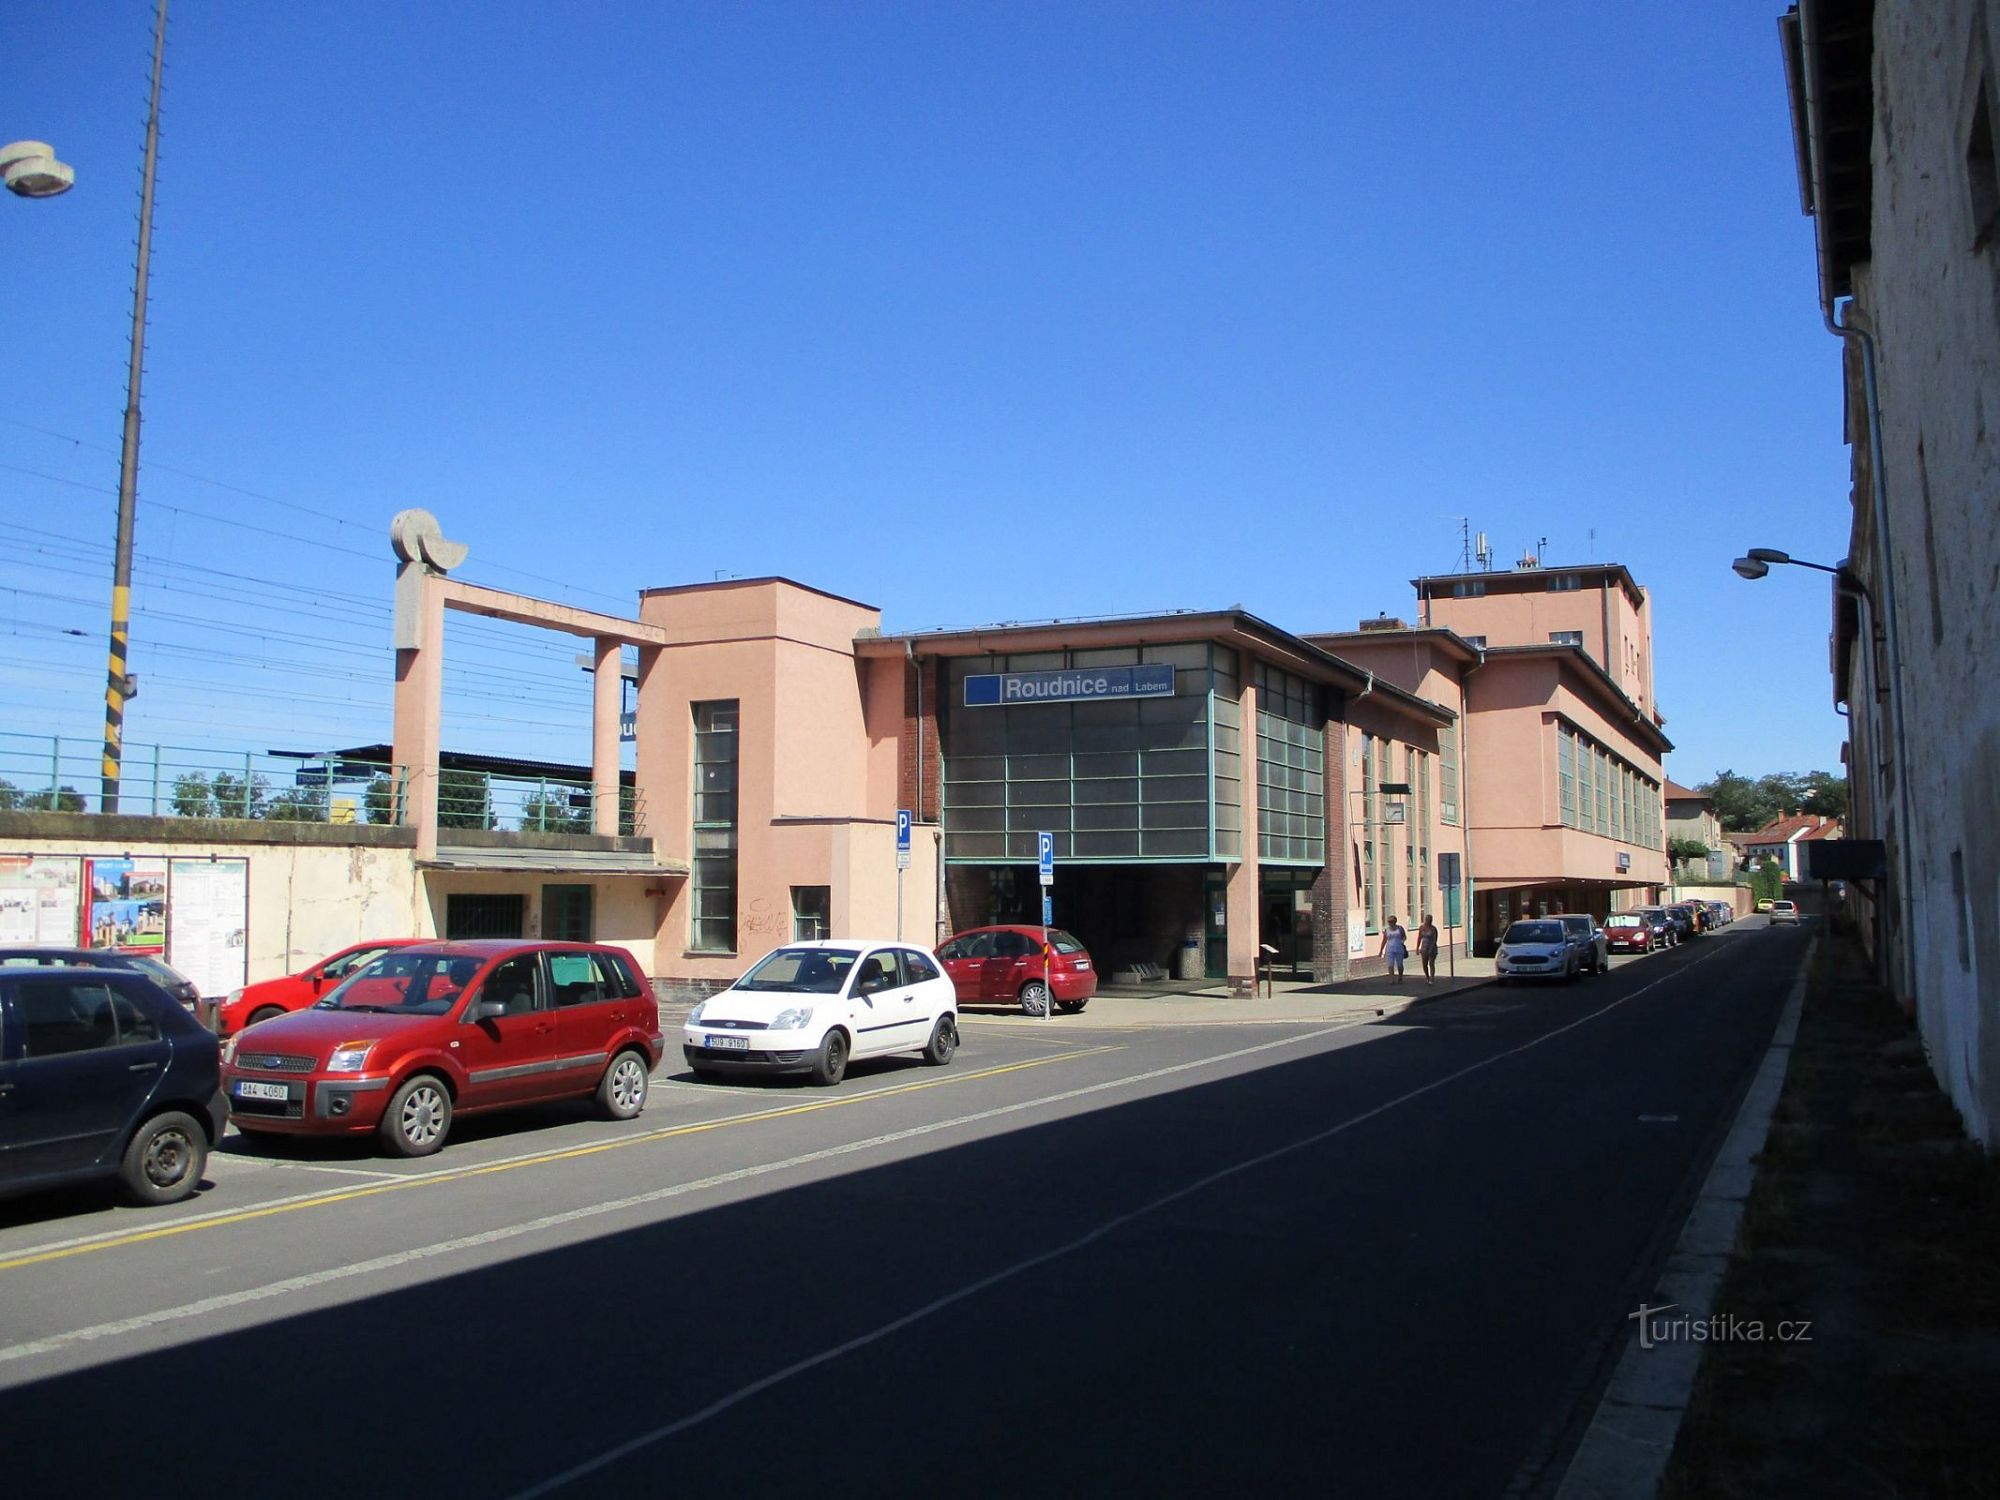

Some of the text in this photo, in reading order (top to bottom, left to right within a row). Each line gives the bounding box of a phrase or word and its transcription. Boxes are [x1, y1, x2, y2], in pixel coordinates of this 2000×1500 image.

[1006, 675, 1167, 699] Roudnice nad Labem
[899, 813, 908, 837] P
[1042, 837, 1050, 862] P
